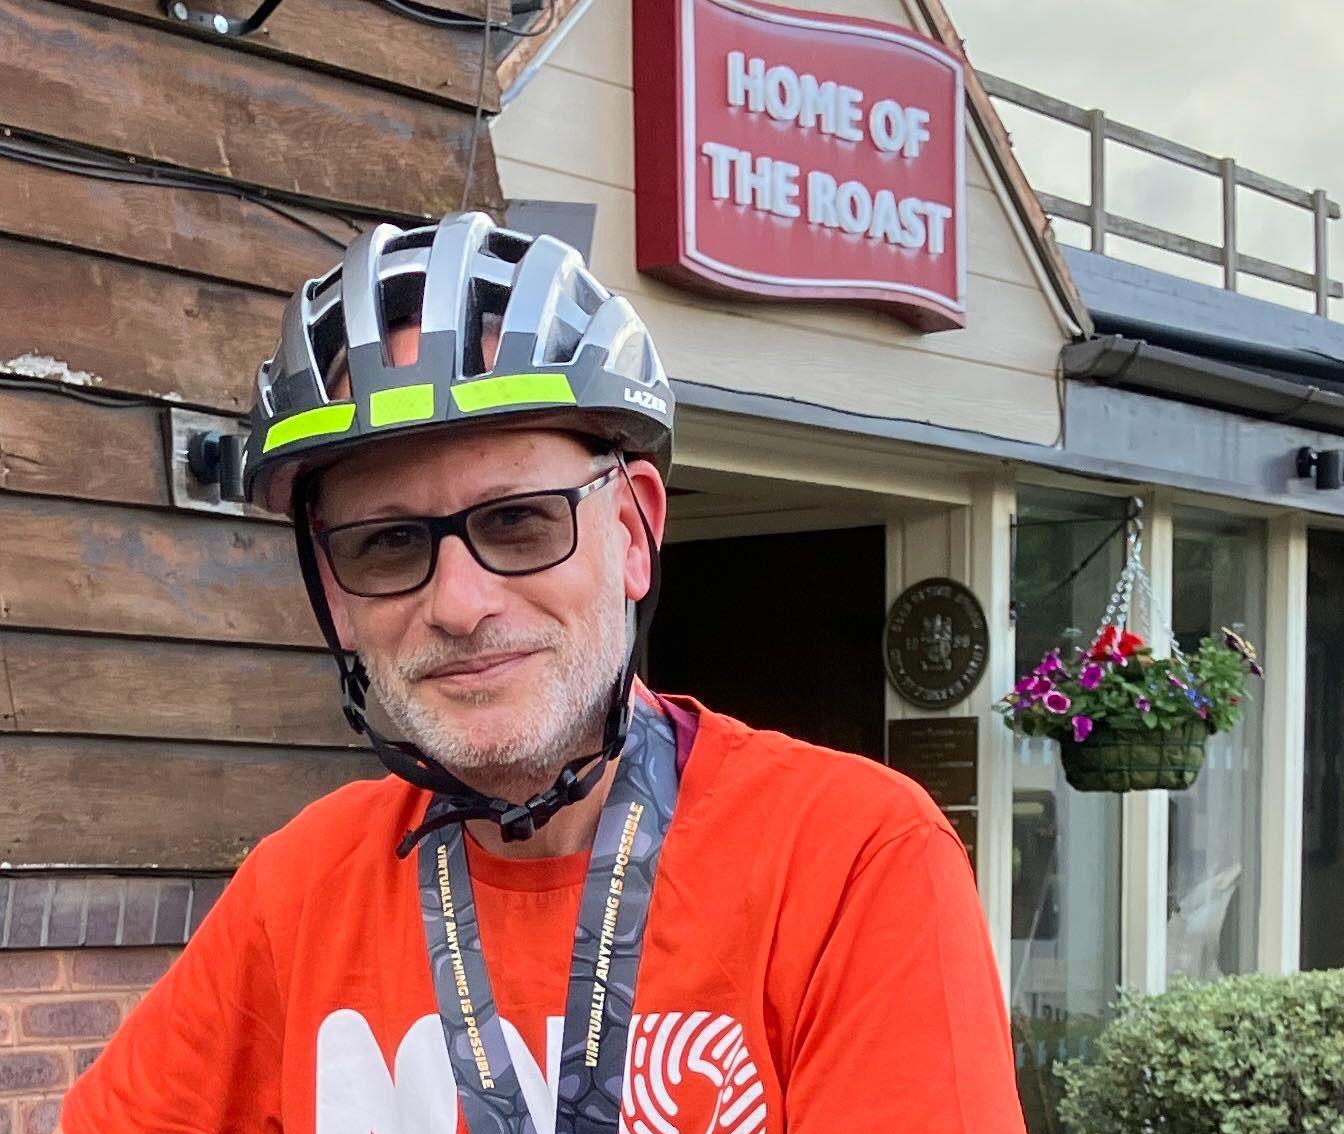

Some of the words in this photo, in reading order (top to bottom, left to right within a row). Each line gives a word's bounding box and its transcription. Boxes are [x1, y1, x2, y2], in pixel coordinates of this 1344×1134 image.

[727, 51, 863, 142] HOME
[870, 100, 930, 158] OF
[702, 142, 800, 218] THE
[807, 171, 953, 254] ROAST
[624, 387, 667, 415] LAZER
[612, 801, 645, 878] POSSIBLE
[437, 844, 455, 918] VIRTUALLY
[610, 878, 624, 895] IS
[445, 921, 469, 997] ANYTHING
[595, 896, 620, 981] ANYTHING
[460, 998, 473, 1015] IS
[585, 982, 606, 1067] VIRTUALLY
[464, 1016, 495, 1090] POSSIBLE
